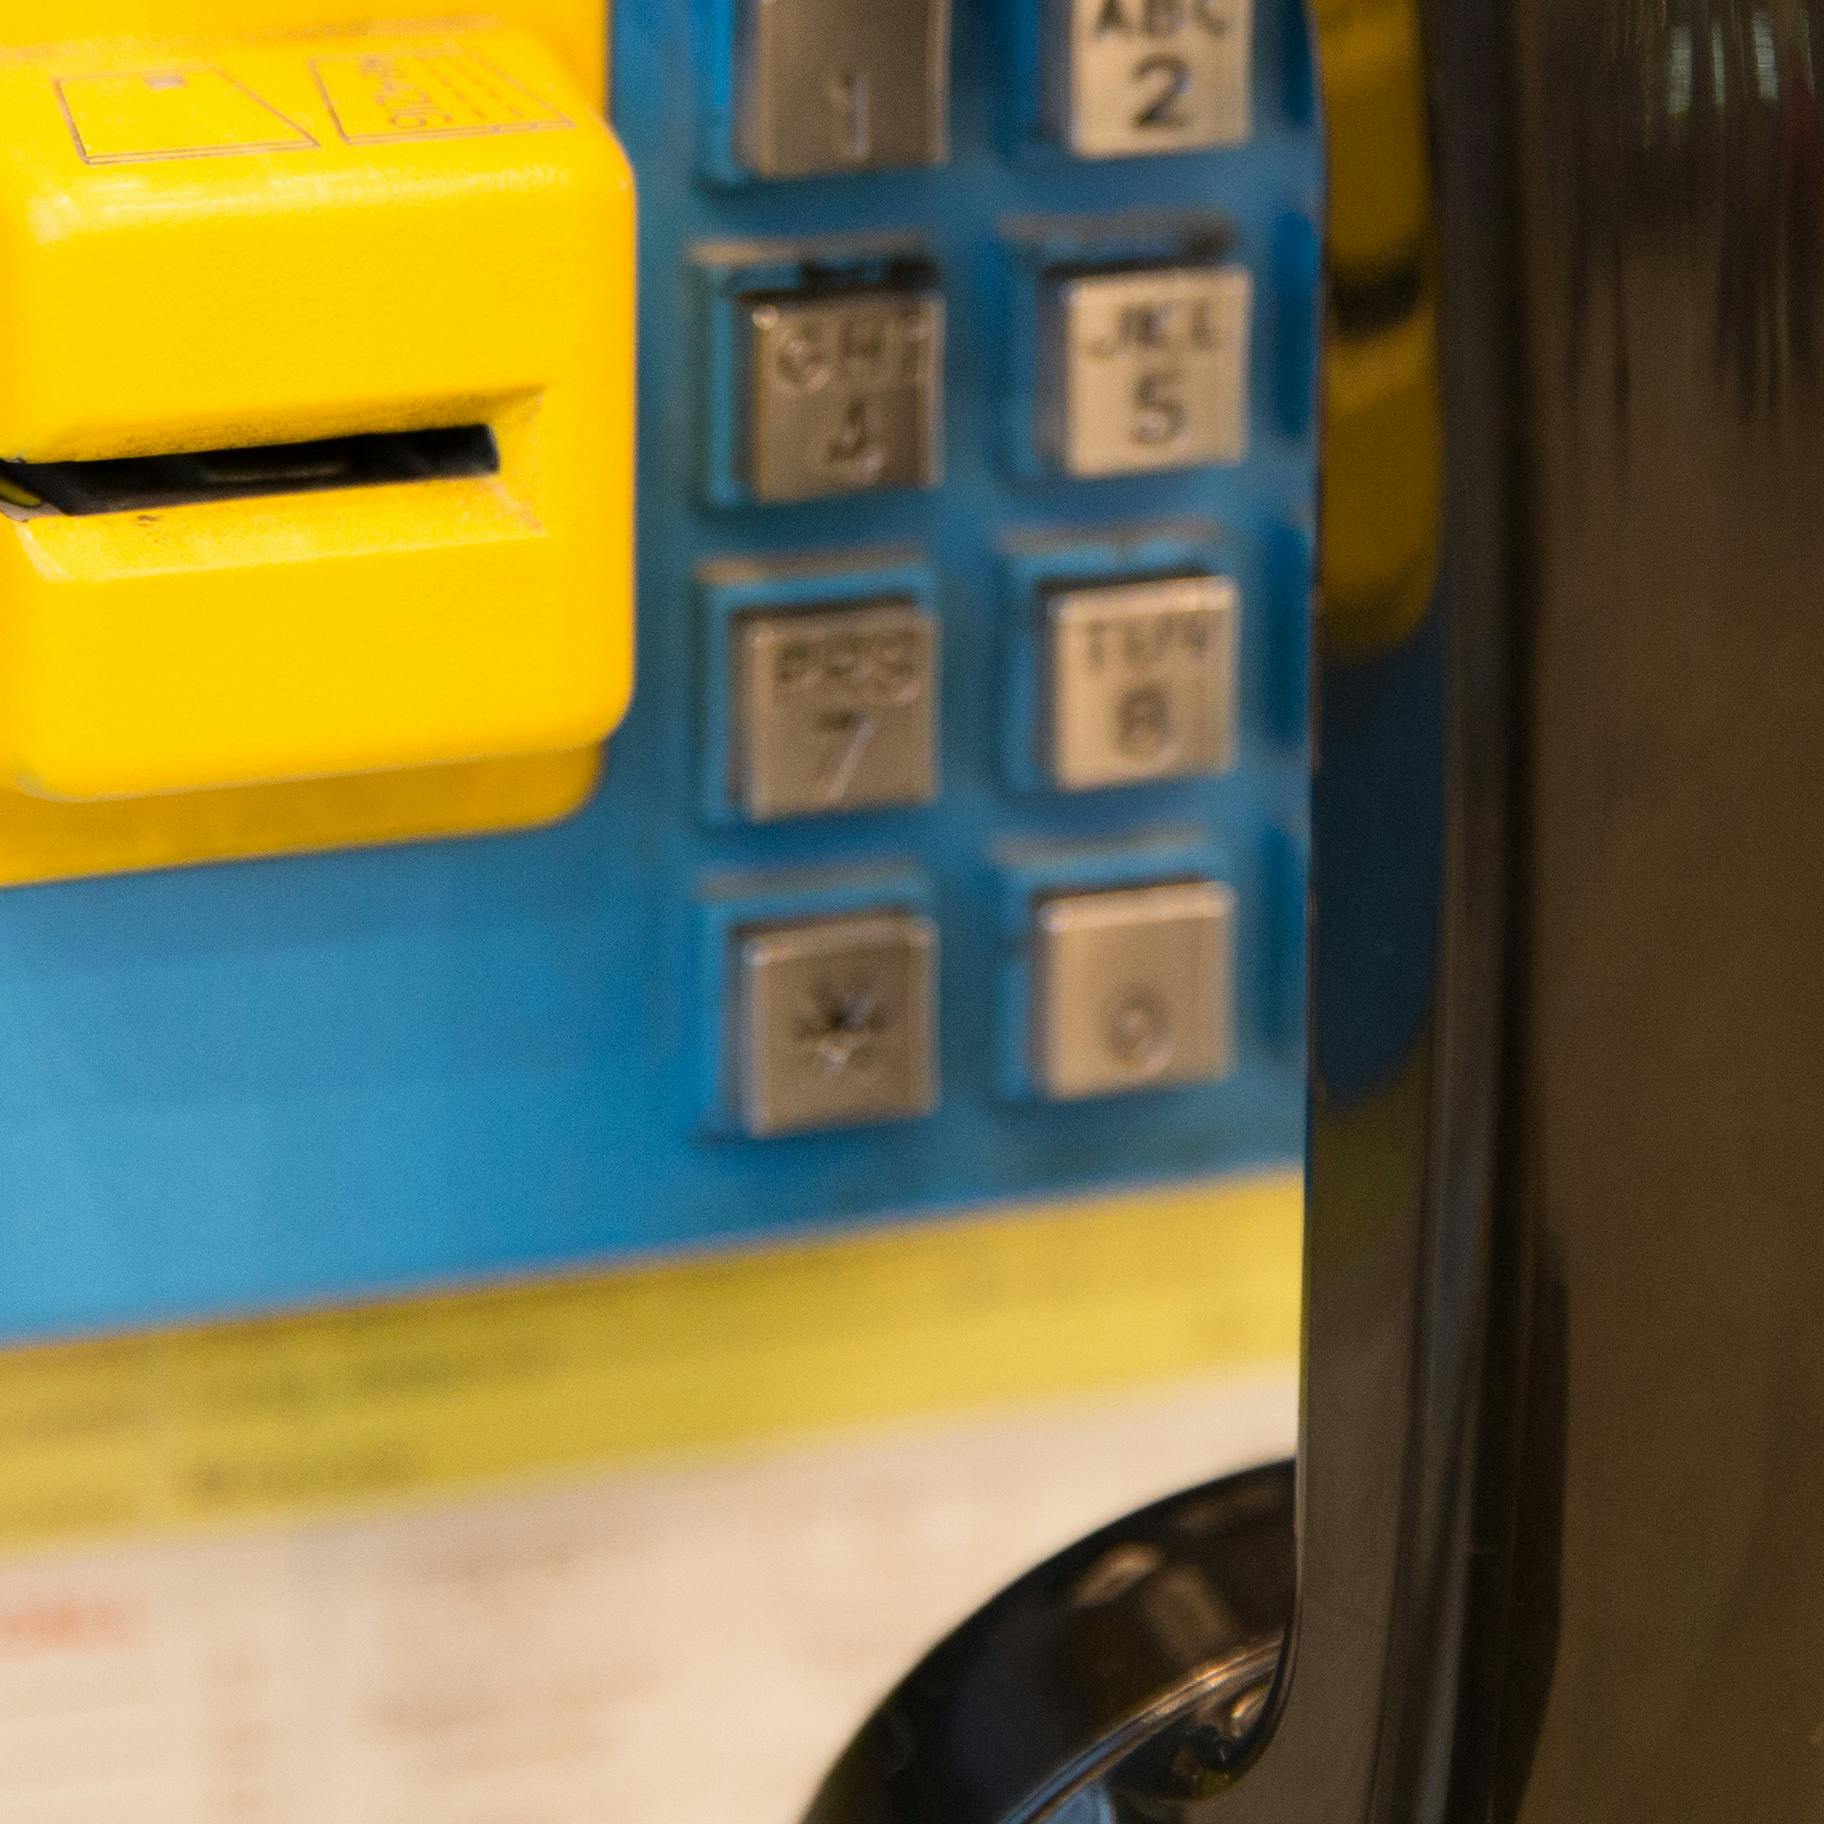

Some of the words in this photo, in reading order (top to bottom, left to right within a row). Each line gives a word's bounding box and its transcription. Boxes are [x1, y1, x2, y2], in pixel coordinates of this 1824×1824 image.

[1130, 56, 1190, 130] 2
[1129, 370, 1190, 449] 5
[816, 708, 876, 803] 7
[1099, 980, 1178, 1078] 0
